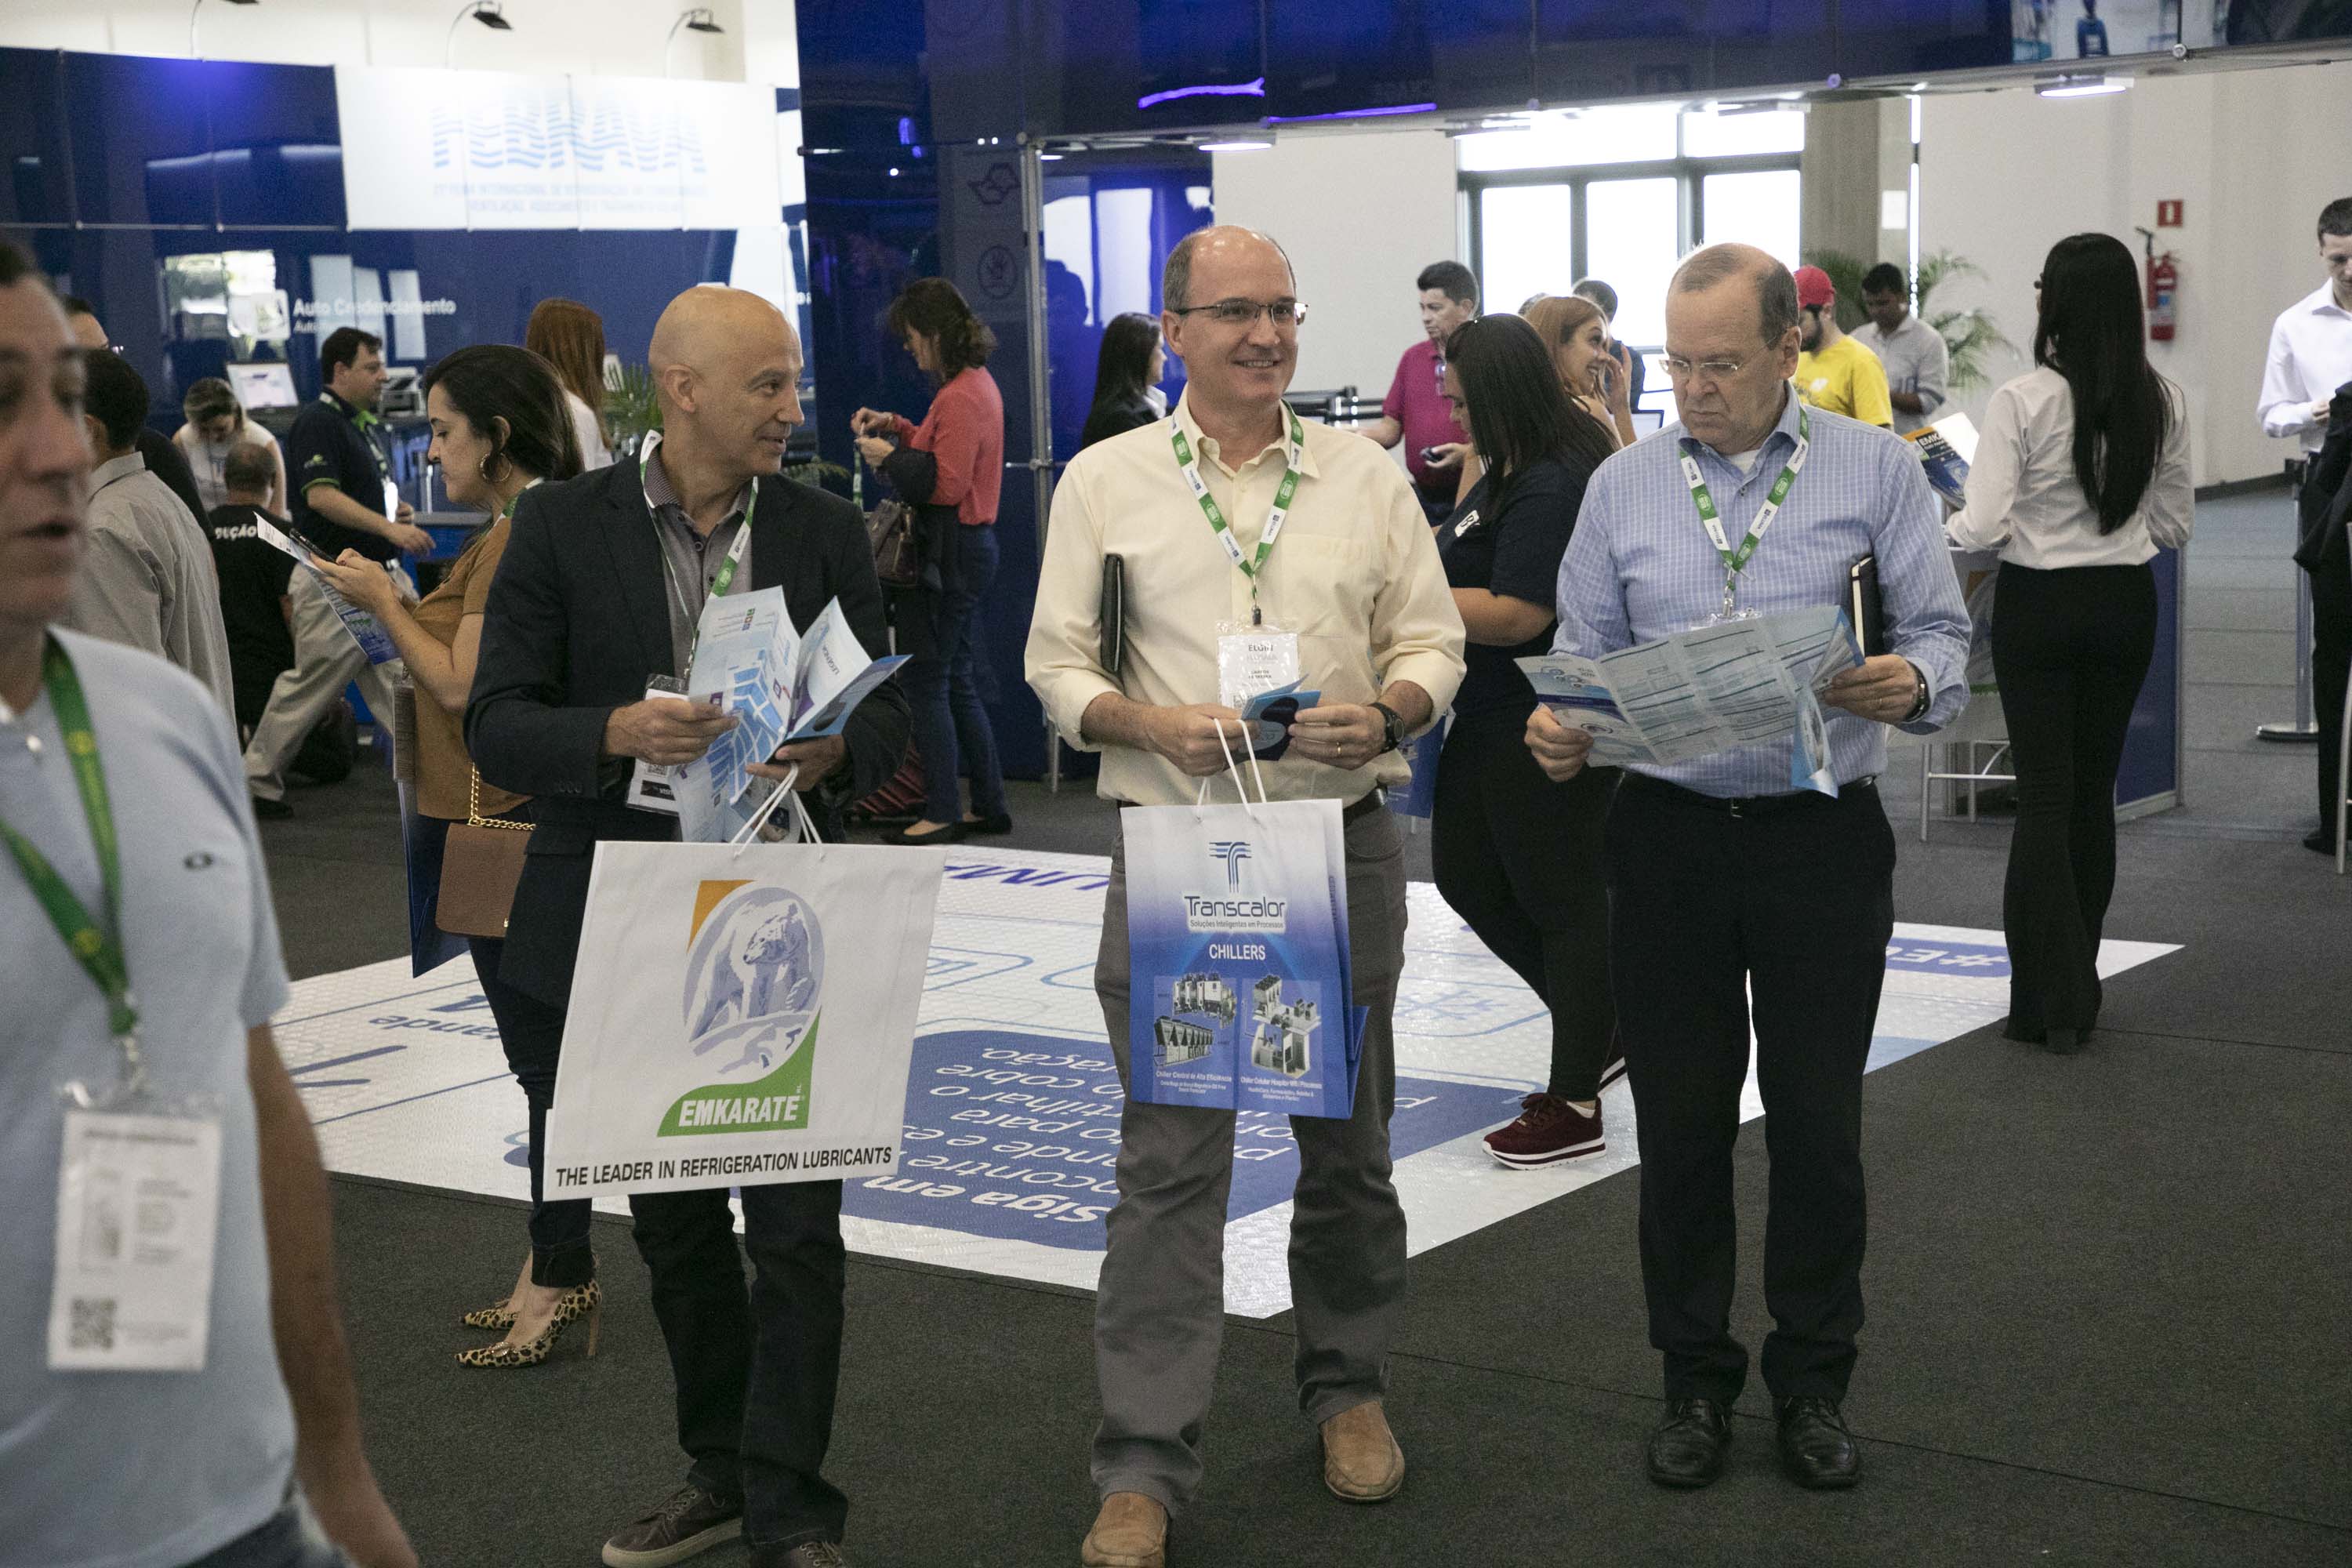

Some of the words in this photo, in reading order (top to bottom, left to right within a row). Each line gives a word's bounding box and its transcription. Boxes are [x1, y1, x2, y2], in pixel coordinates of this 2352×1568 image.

[214, 523, 257, 541] DUÇÃO
[1184, 896, 1286, 917] Transcalor
[1190, 920, 1215, 928] Soluções
[1216, 920, 1247, 929] Inteligentes
[1256, 920, 1283, 929] Processos
[1209, 944, 1266, 960] CHILLERS
[368, 1015, 502, 1039] ande
[982, 1048, 1116, 1072] ração.
[936, 1065, 1085, 1087] cobre
[929, 1087, 970, 1096] o
[678, 1095, 800, 1127] EMKARATE
[968, 1092, 1122, 1117] rtilhar
[950, 1109, 1086, 1133] para
[946, 1135, 987, 1145] e
[557, 1167, 588, 1186] THE
[593, 1162, 652, 1184] LEADER
[659, 1161, 674, 1178] IN
[680, 1152, 797, 1178] REFRIGERATION
[803, 1146, 892, 1169] LUBRICANTS
[993, 1141, 1118, 1167] ande
[863, 1175, 966, 1197] em
[907, 1156, 1120, 1193] ncontre
[971, 1191, 1112, 1222] Siga
